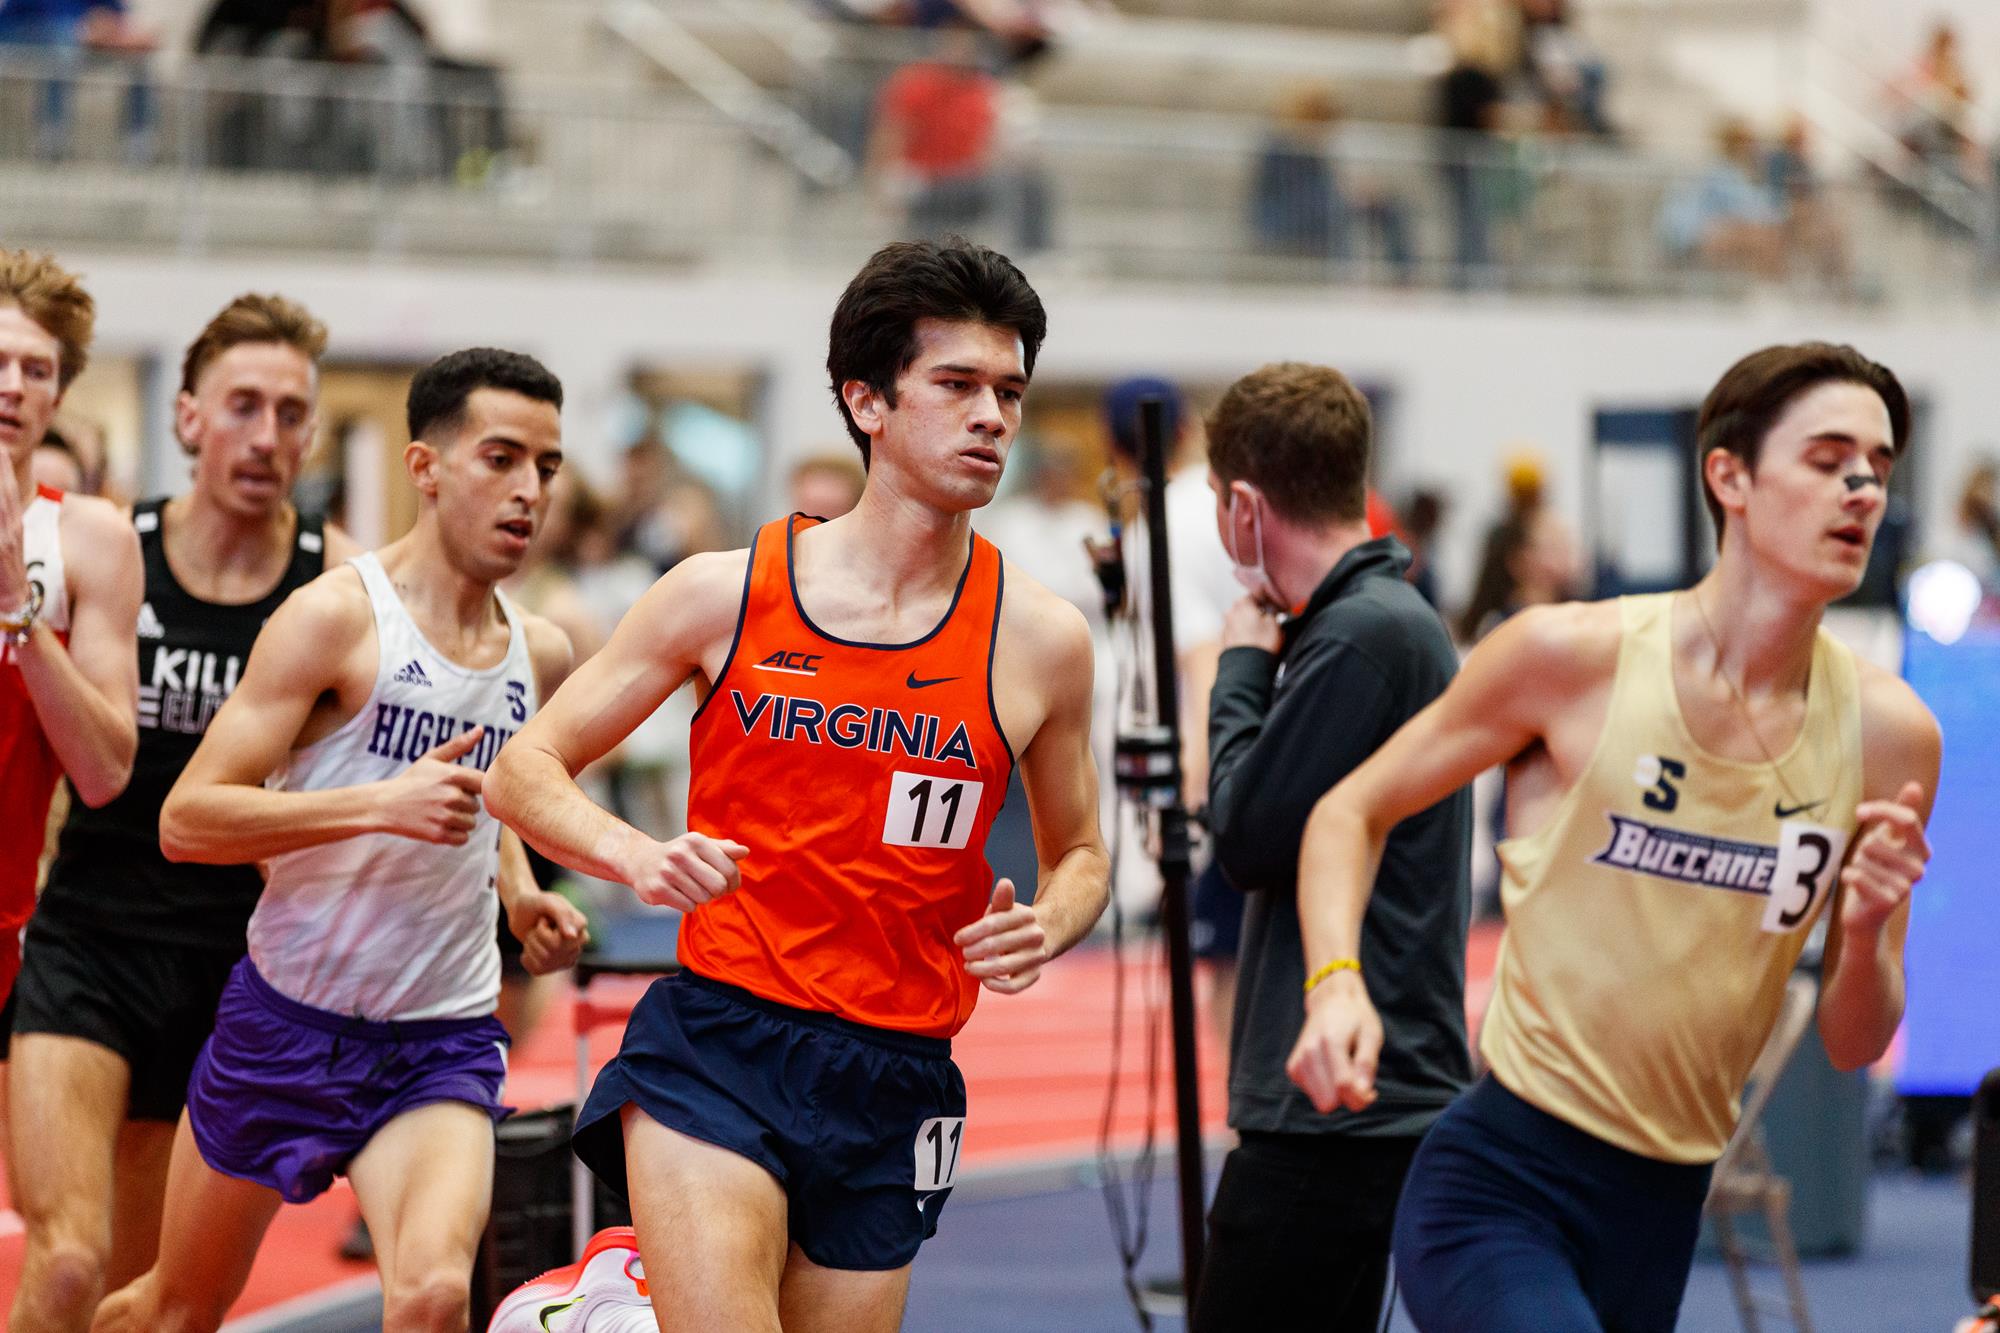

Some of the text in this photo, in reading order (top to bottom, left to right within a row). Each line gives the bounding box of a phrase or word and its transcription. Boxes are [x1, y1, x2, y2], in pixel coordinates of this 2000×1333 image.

[761, 650, 824, 672] ACC
[367, 702, 455, 763] HIGH
[731, 690, 977, 769] VIRGINIA
[908, 779, 964, 844] 11
[1778, 833, 1831, 927] 3
[926, 1121, 962, 1185] 11
